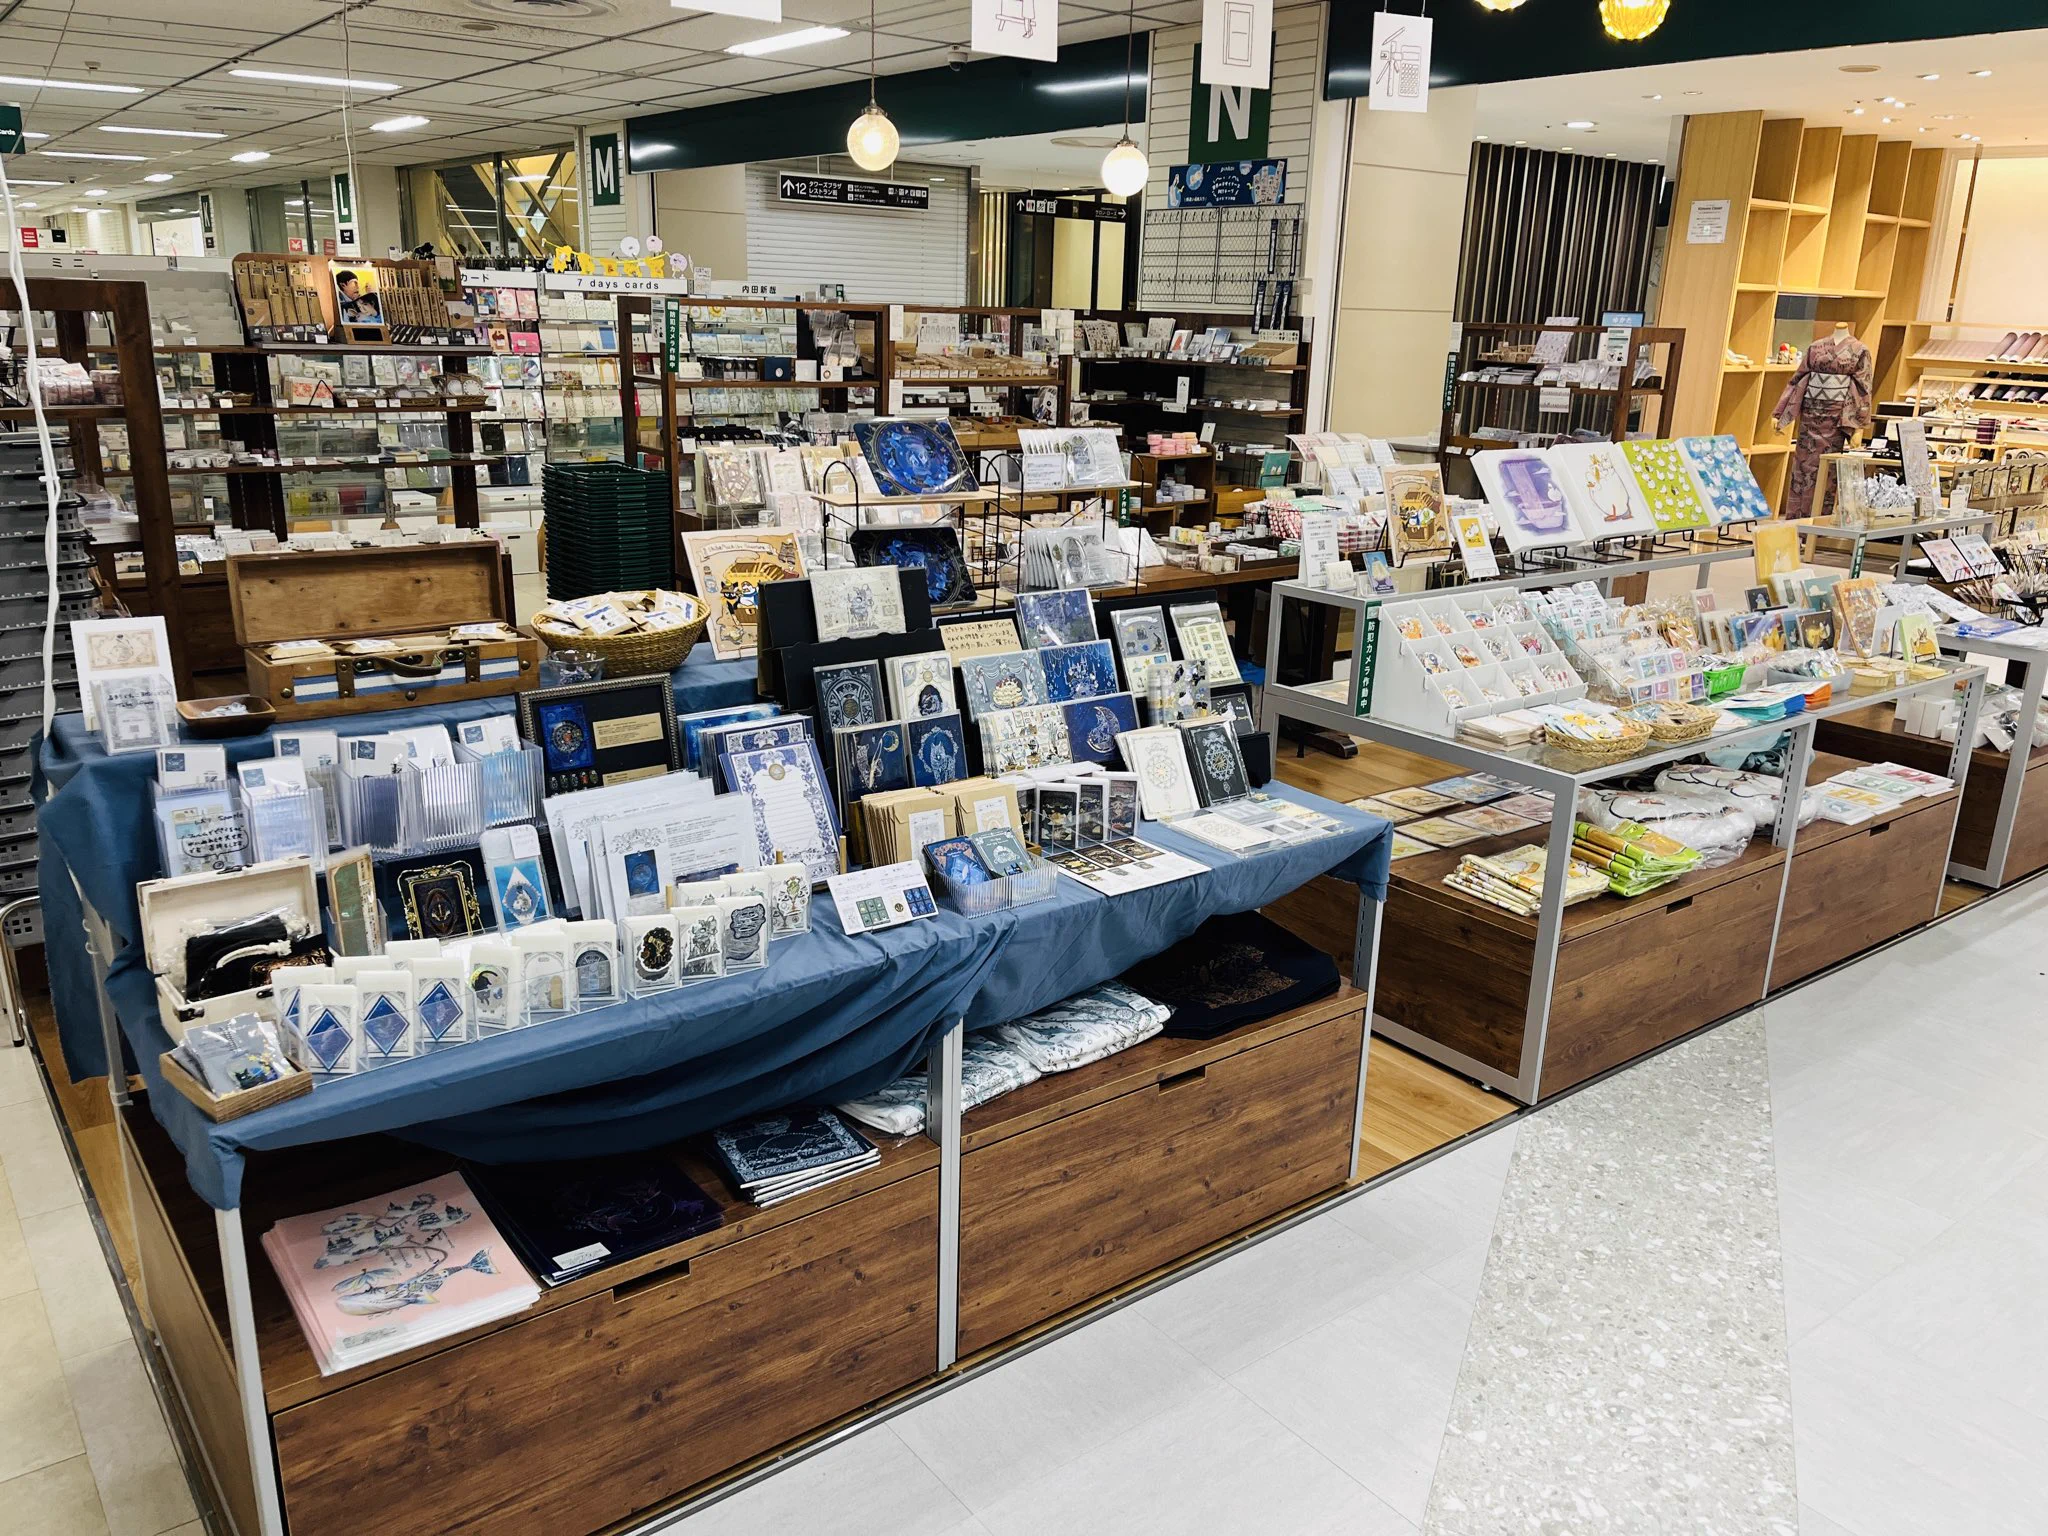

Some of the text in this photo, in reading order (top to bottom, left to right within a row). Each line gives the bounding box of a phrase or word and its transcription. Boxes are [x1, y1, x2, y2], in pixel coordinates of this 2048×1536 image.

[1207, 84, 1252, 142] N
[595, 146, 615, 195] M
[808, 180, 842, 190] タワーズプラザ
[338, 182, 349, 216] L
[795, 182, 807, 195] 12
[201, 201, 211, 228] K
[52, 257, 85, 268] ミニ
[577, 278, 659, 290] 7 days cards
[668, 311, 677, 369] 防犯カメラ作動中
[1360, 621, 1376, 709] 防犯カメラ作動中
